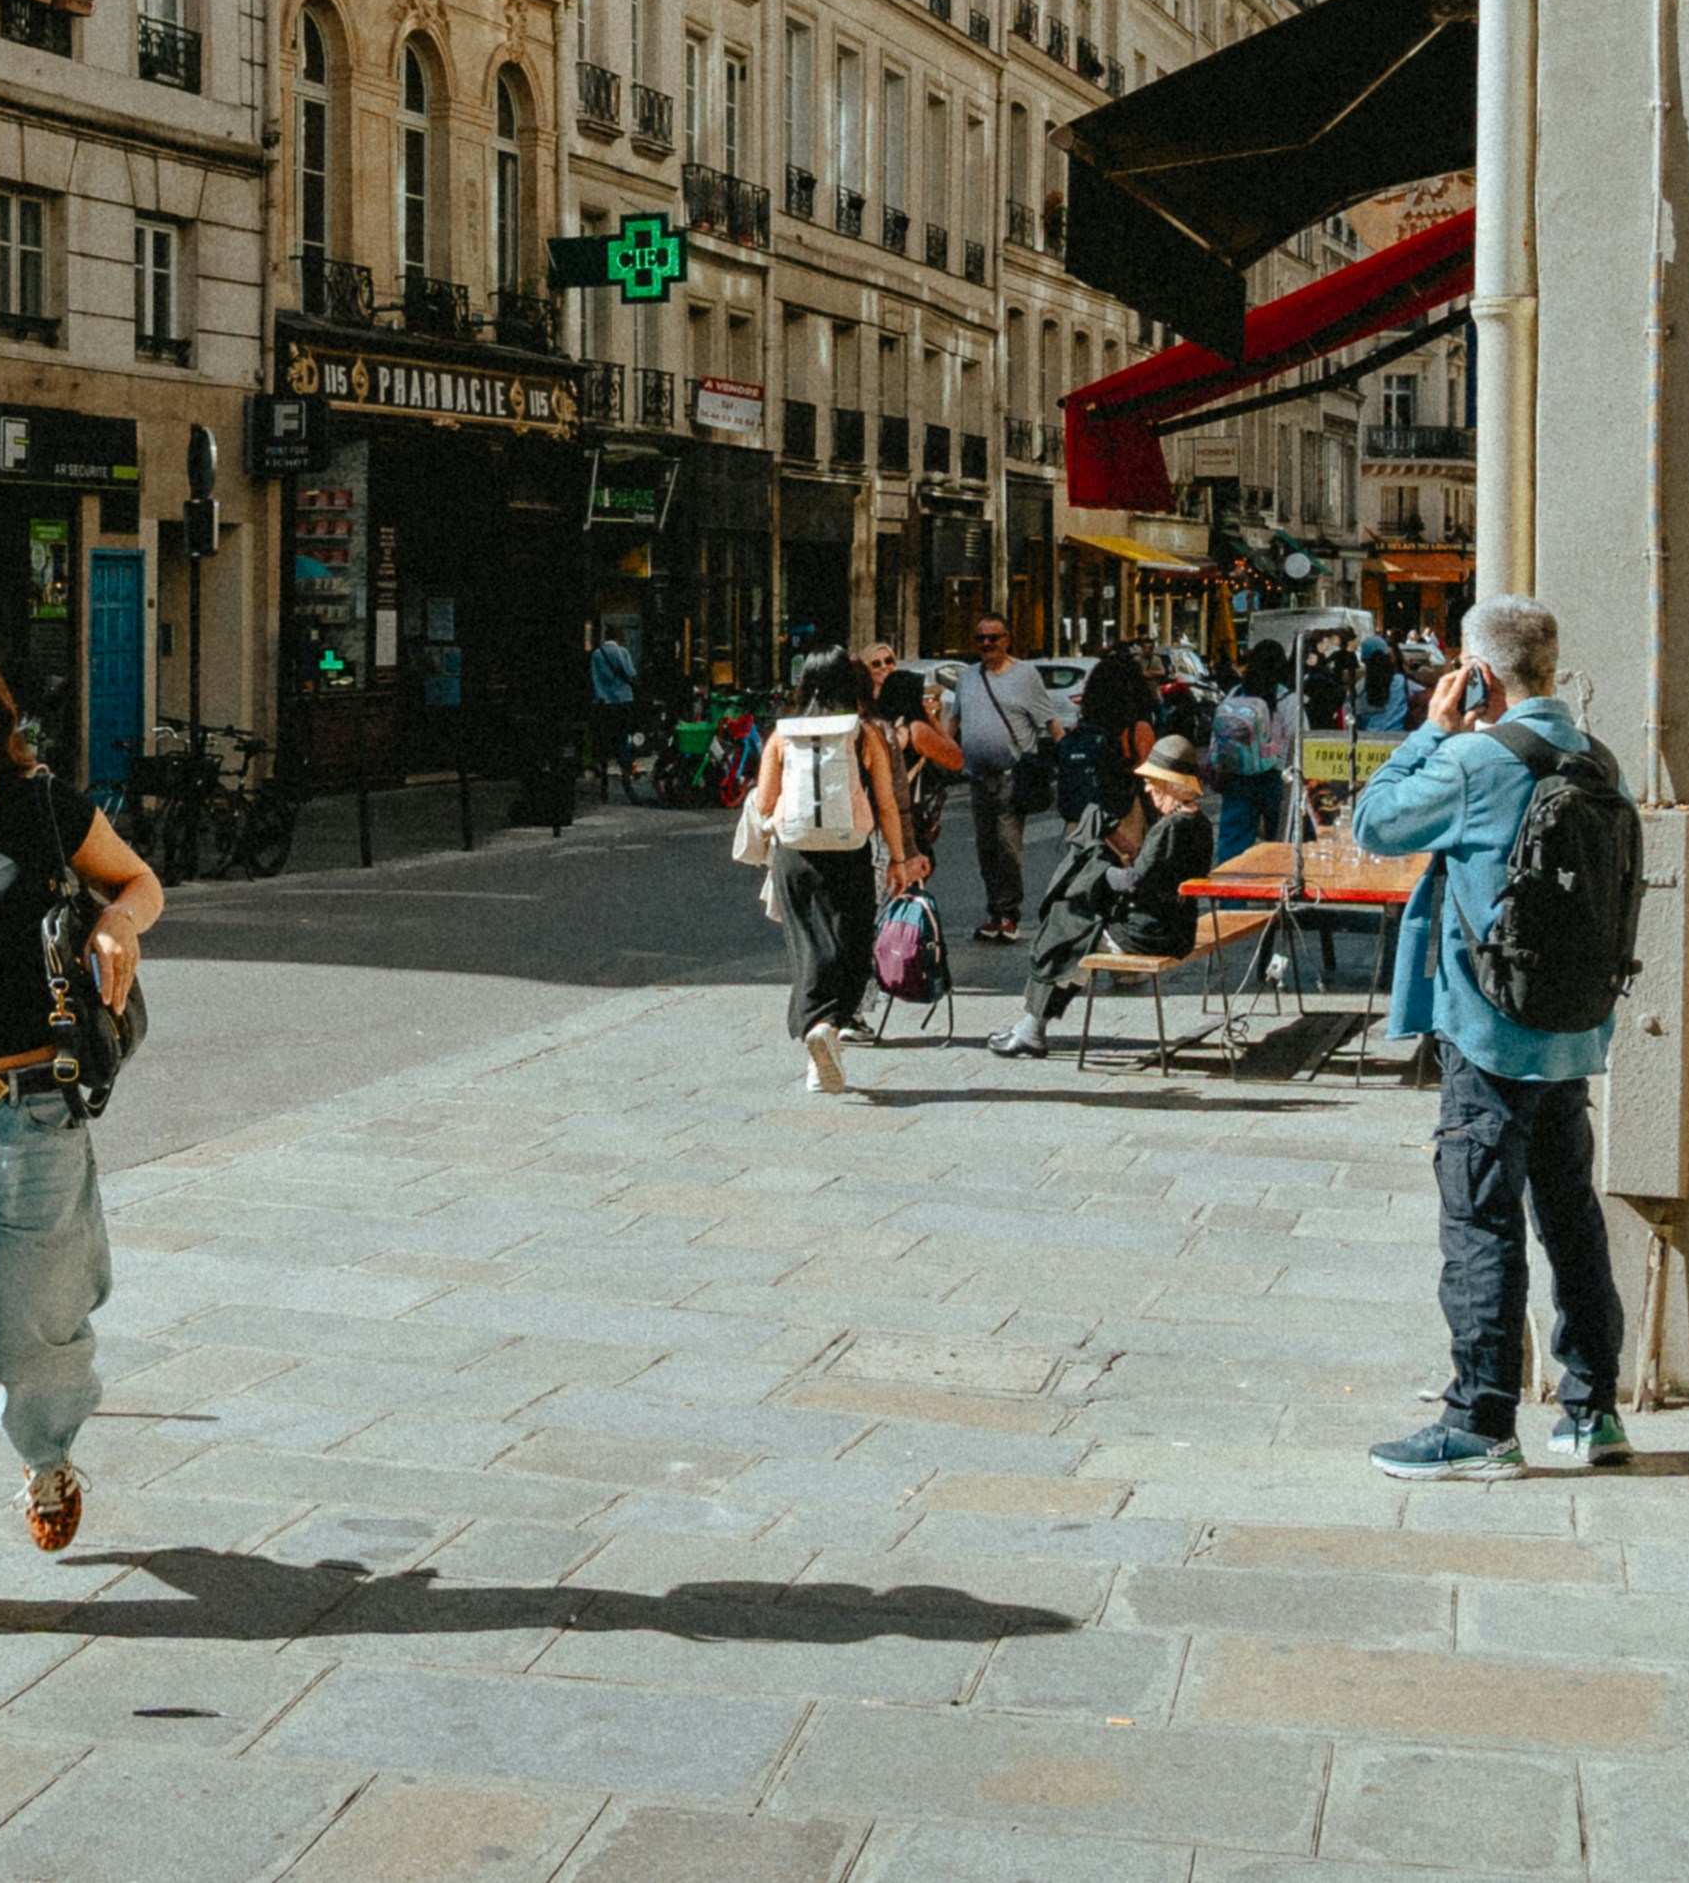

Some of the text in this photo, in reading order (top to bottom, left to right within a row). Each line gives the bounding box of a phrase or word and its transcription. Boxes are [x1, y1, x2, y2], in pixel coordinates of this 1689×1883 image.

[325, 363, 549, 417] 115 PHARMACIE 115
[704, 380, 760, 397] A VENDRE
[54, 463, 67, 475] AR
[1315, 750, 1362, 761] FORMUE
[1485, 1437, 1519, 1457] HOKA
